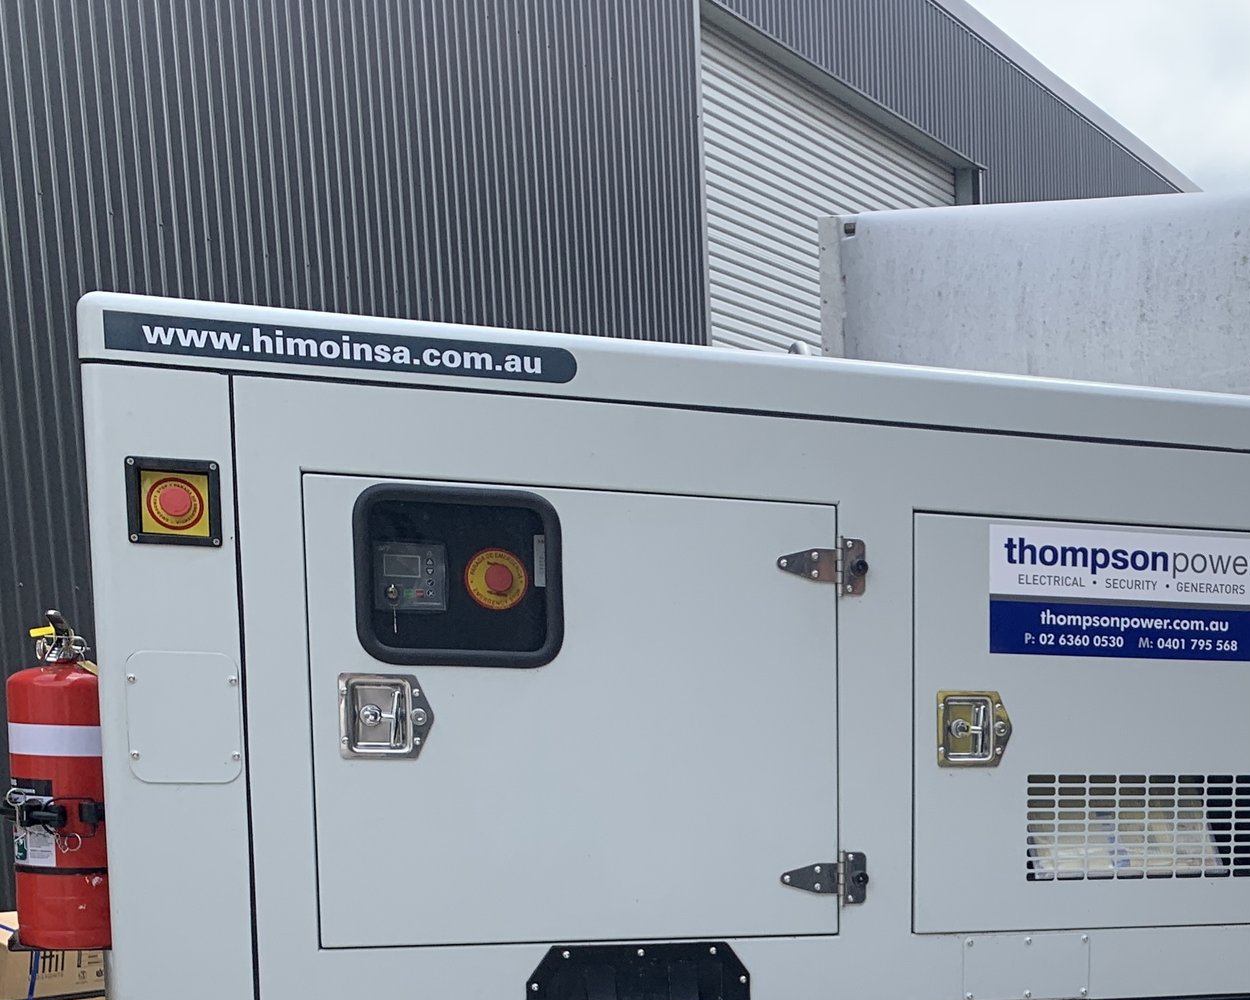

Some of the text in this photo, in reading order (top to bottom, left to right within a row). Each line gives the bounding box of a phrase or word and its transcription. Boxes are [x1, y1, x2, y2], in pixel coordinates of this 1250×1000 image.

[141, 324, 542, 374] www.himoinsa.com.au
[1018, 574, 1246, 594] ELECTRICAL SECURITY GENERATORS
[1040, 609, 1229, 632] thompsonpower.com.au
[1024, 633, 1238, 652] P: 02 6360 0530 M: 0401 795 568
